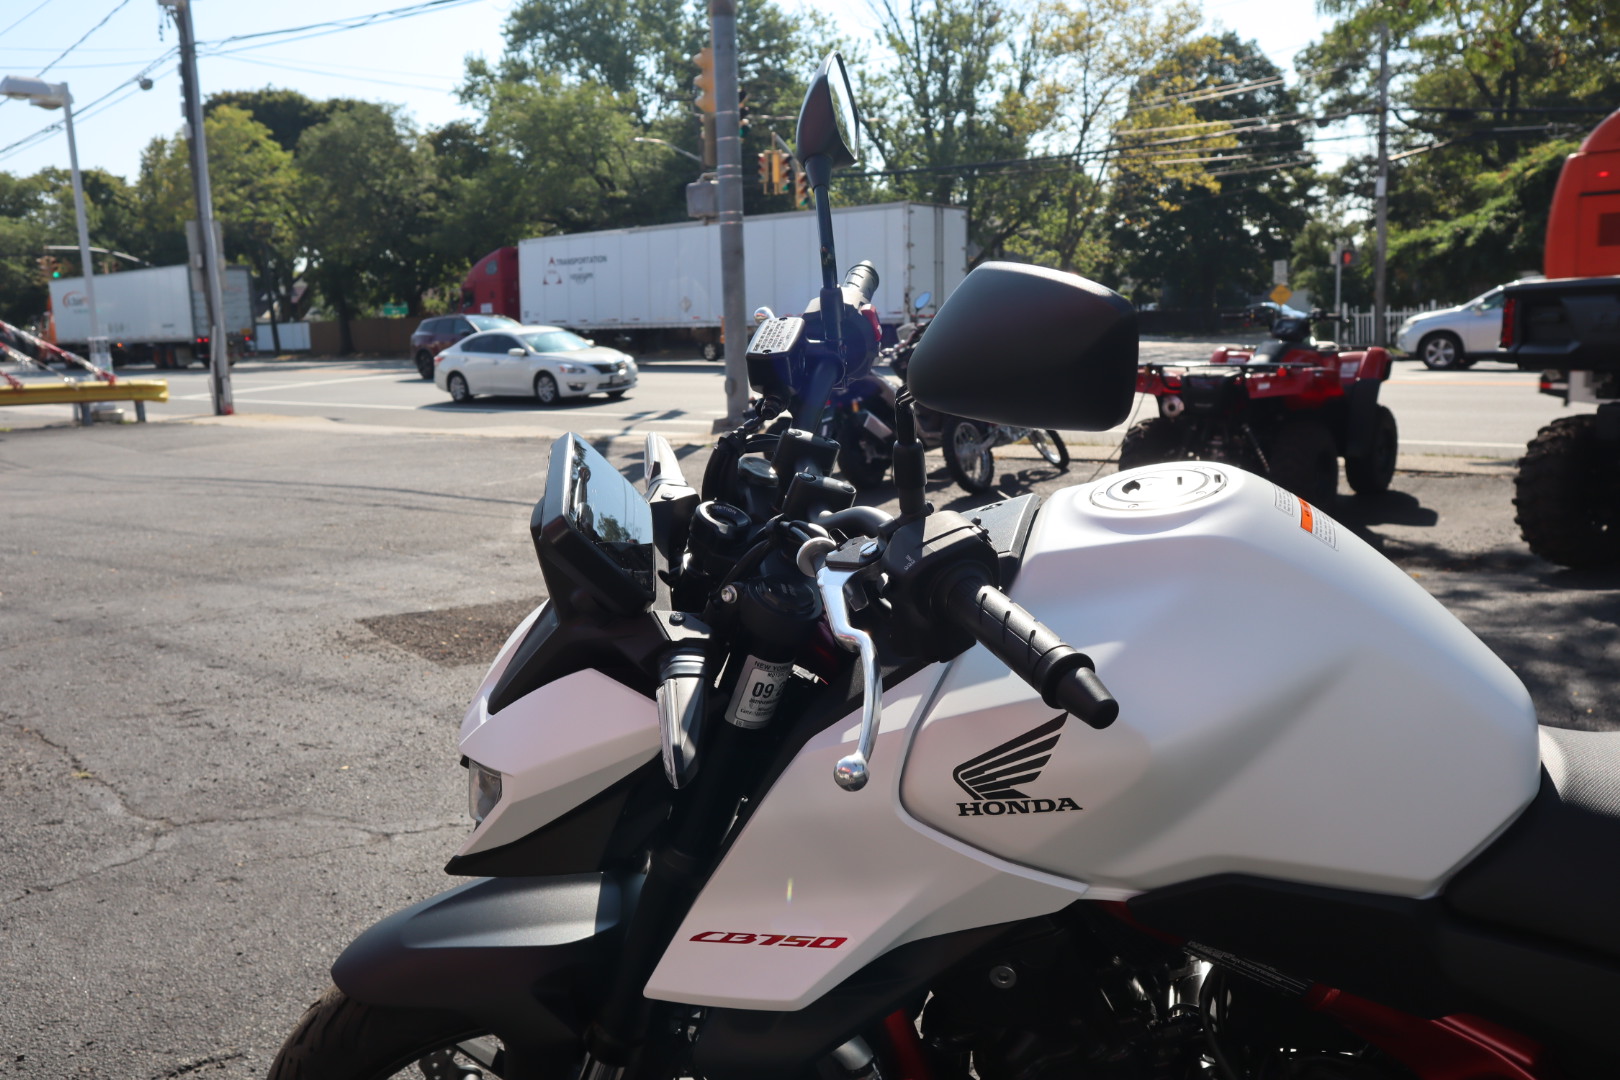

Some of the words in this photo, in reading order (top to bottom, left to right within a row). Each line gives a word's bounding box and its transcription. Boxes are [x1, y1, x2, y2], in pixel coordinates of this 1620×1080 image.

[556, 255, 608, 266] TRANSPORTATION
[754, 660, 772, 671] NEW
[752, 681, 775, 699] 09
[956, 797, 1084, 817] HONDA
[688, 931, 848, 949] CB750
